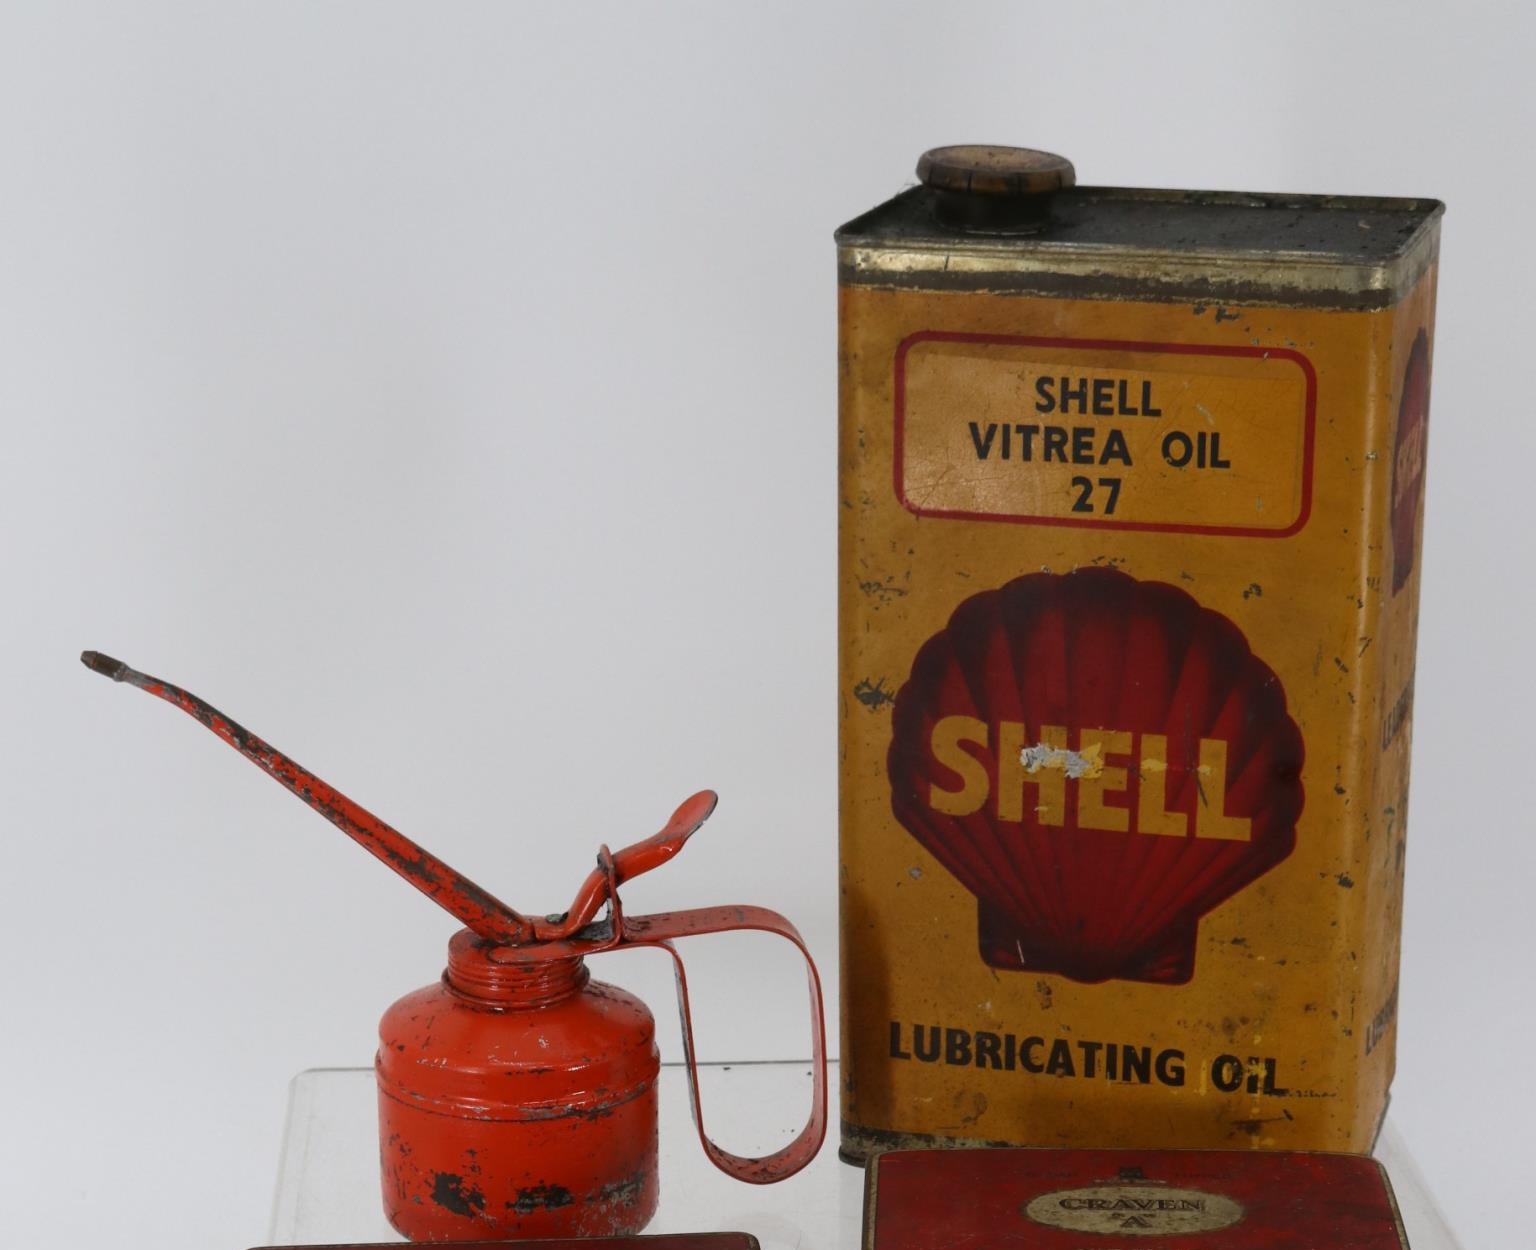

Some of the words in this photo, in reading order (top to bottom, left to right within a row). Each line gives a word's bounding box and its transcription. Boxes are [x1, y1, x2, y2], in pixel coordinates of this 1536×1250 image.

[1034, 376, 1162, 418] SHELL
[968, 421, 1133, 467] VITREA
[1161, 430, 1232, 469] OIL
[1071, 476, 1122, 515] 27
[929, 715, 1252, 841] SHELL
[888, 1021, 1186, 1087] LUBRICATING
[1211, 1053, 1289, 1096] OIL
[1058, 1198, 1207, 1212] CRAVEN
